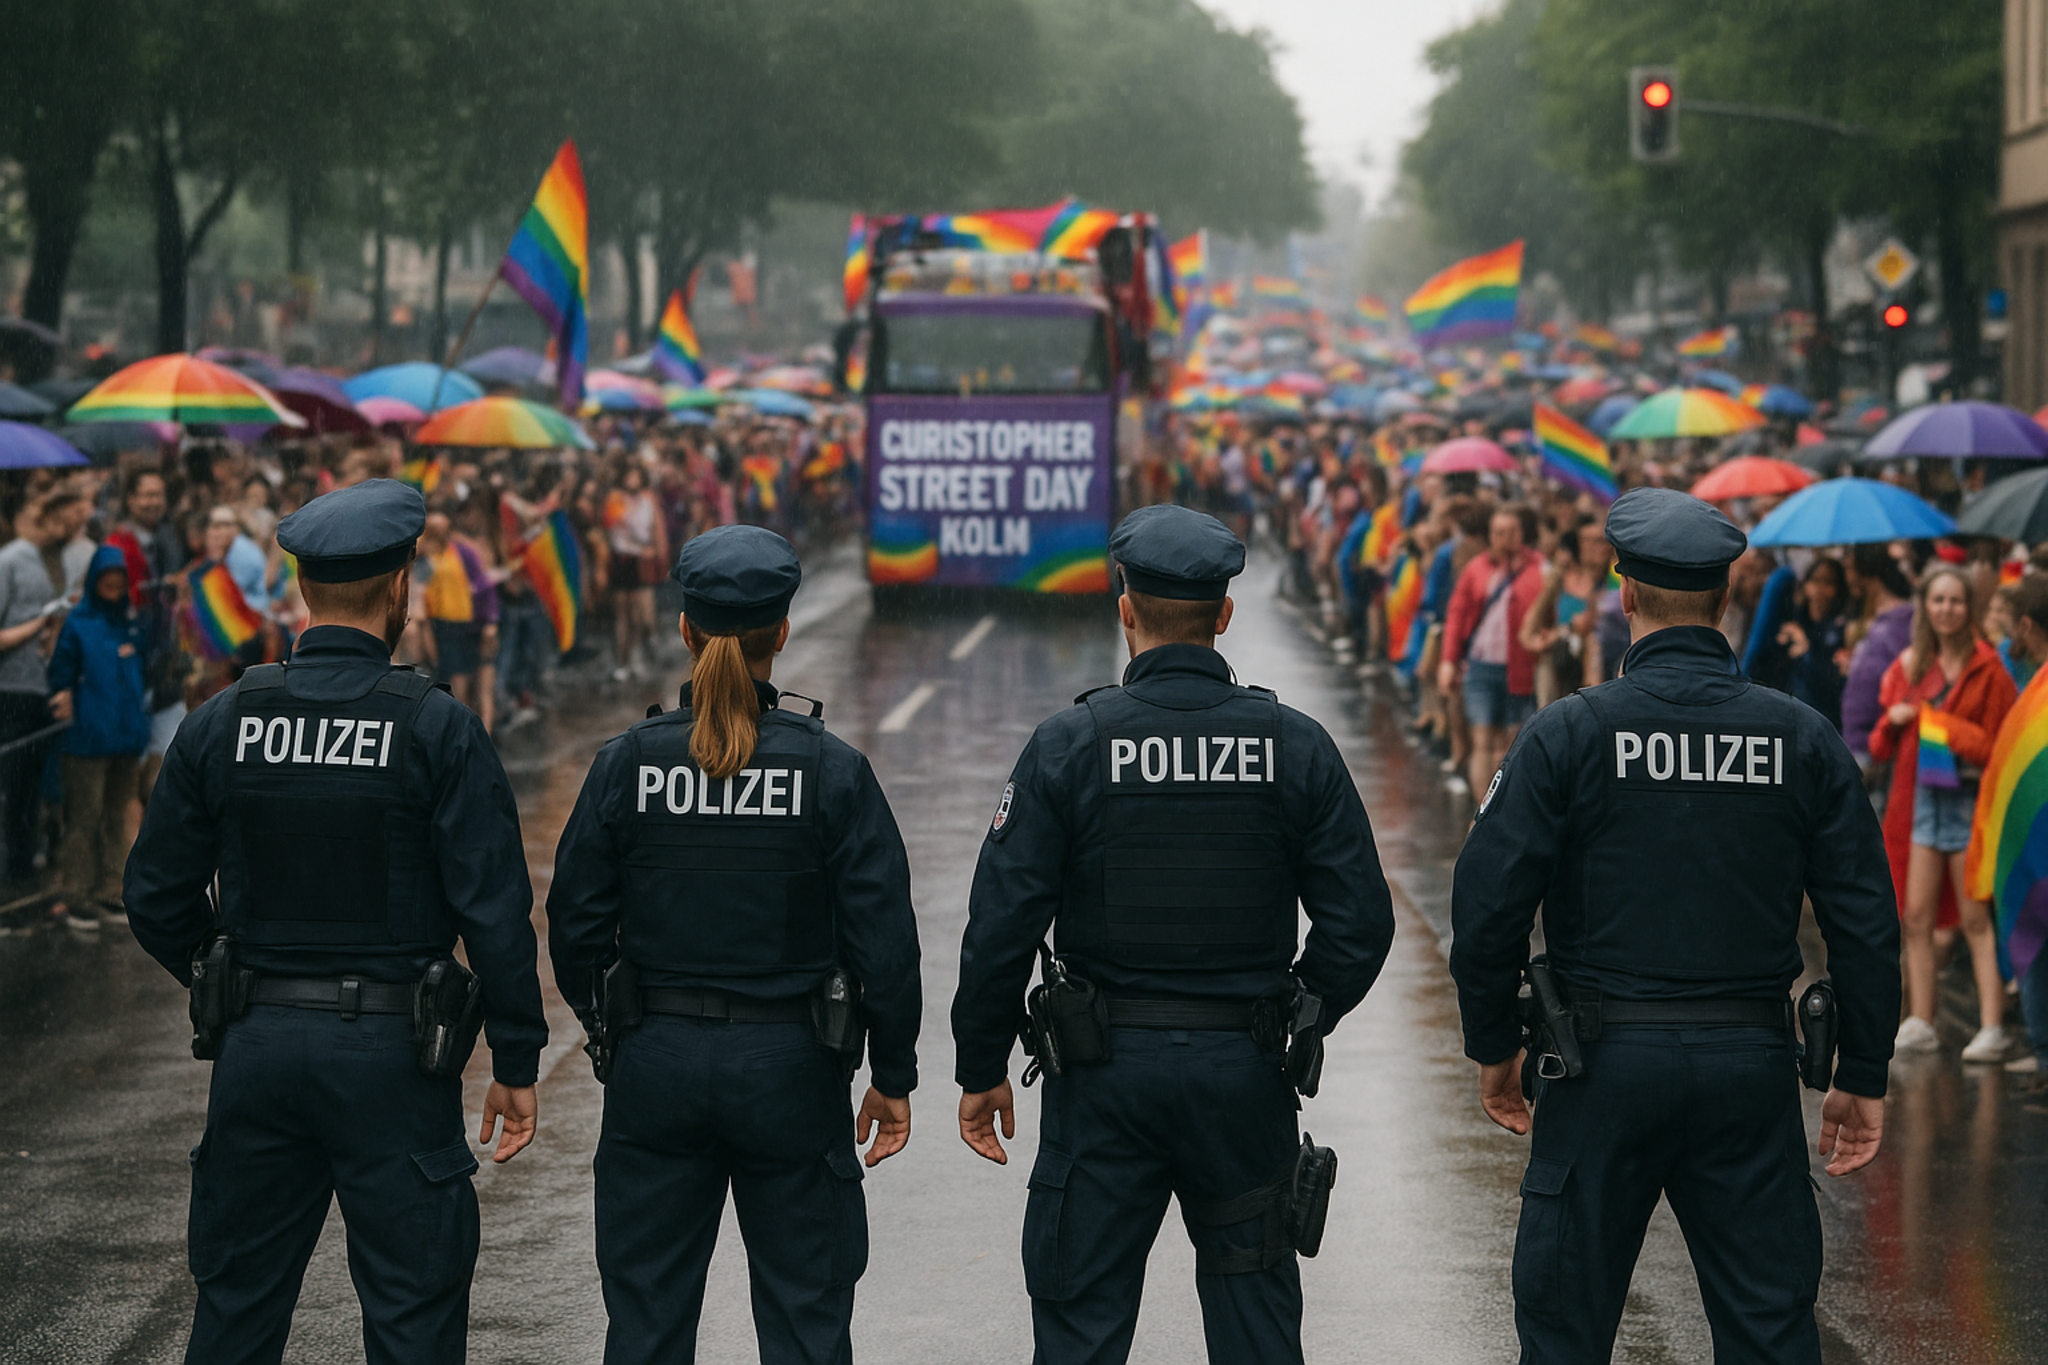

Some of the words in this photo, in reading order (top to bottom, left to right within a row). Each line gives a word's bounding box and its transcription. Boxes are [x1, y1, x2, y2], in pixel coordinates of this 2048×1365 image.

[880, 465, 1013, 510] STREET
[1025, 465, 1093, 510] DAY
[236, 717, 394, 767] POLIZEI
[1111, 736, 1274, 783] POLIZEI
[1615, 731, 1783, 785] POLIZEI
[637, 765, 803, 816] POLIZEI
